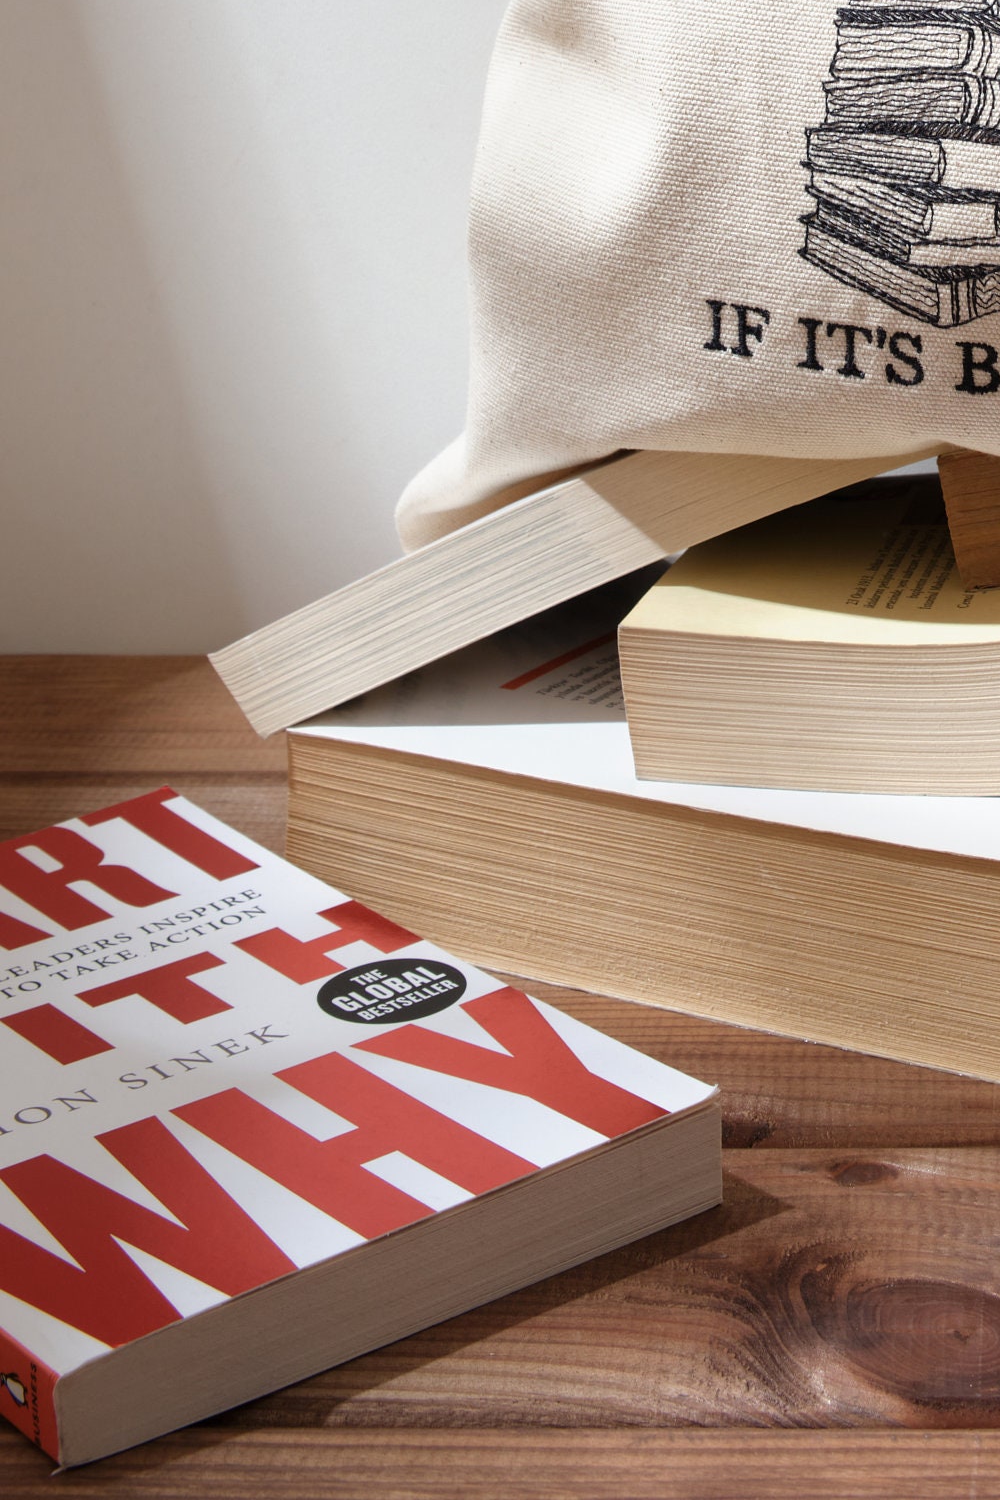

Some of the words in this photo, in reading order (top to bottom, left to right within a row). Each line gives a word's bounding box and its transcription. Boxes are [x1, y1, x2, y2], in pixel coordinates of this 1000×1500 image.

[703, 299, 770, 358] IF
[798, 316, 925, 387] IT'S
[137, 888, 263, 935] INSPIRE
[0, 980, 42, 1000] TO
[49, 949, 138, 982] TAKE
[150, 905, 267, 952] ACTION
[349, 968, 389, 987] THE
[331, 966, 447, 1012] GLOBAL
[356, 979, 460, 1021] BESTSELLER
[119, 1024, 290, 1090] SINEK
[0, 984, 673, 1349] WHY
